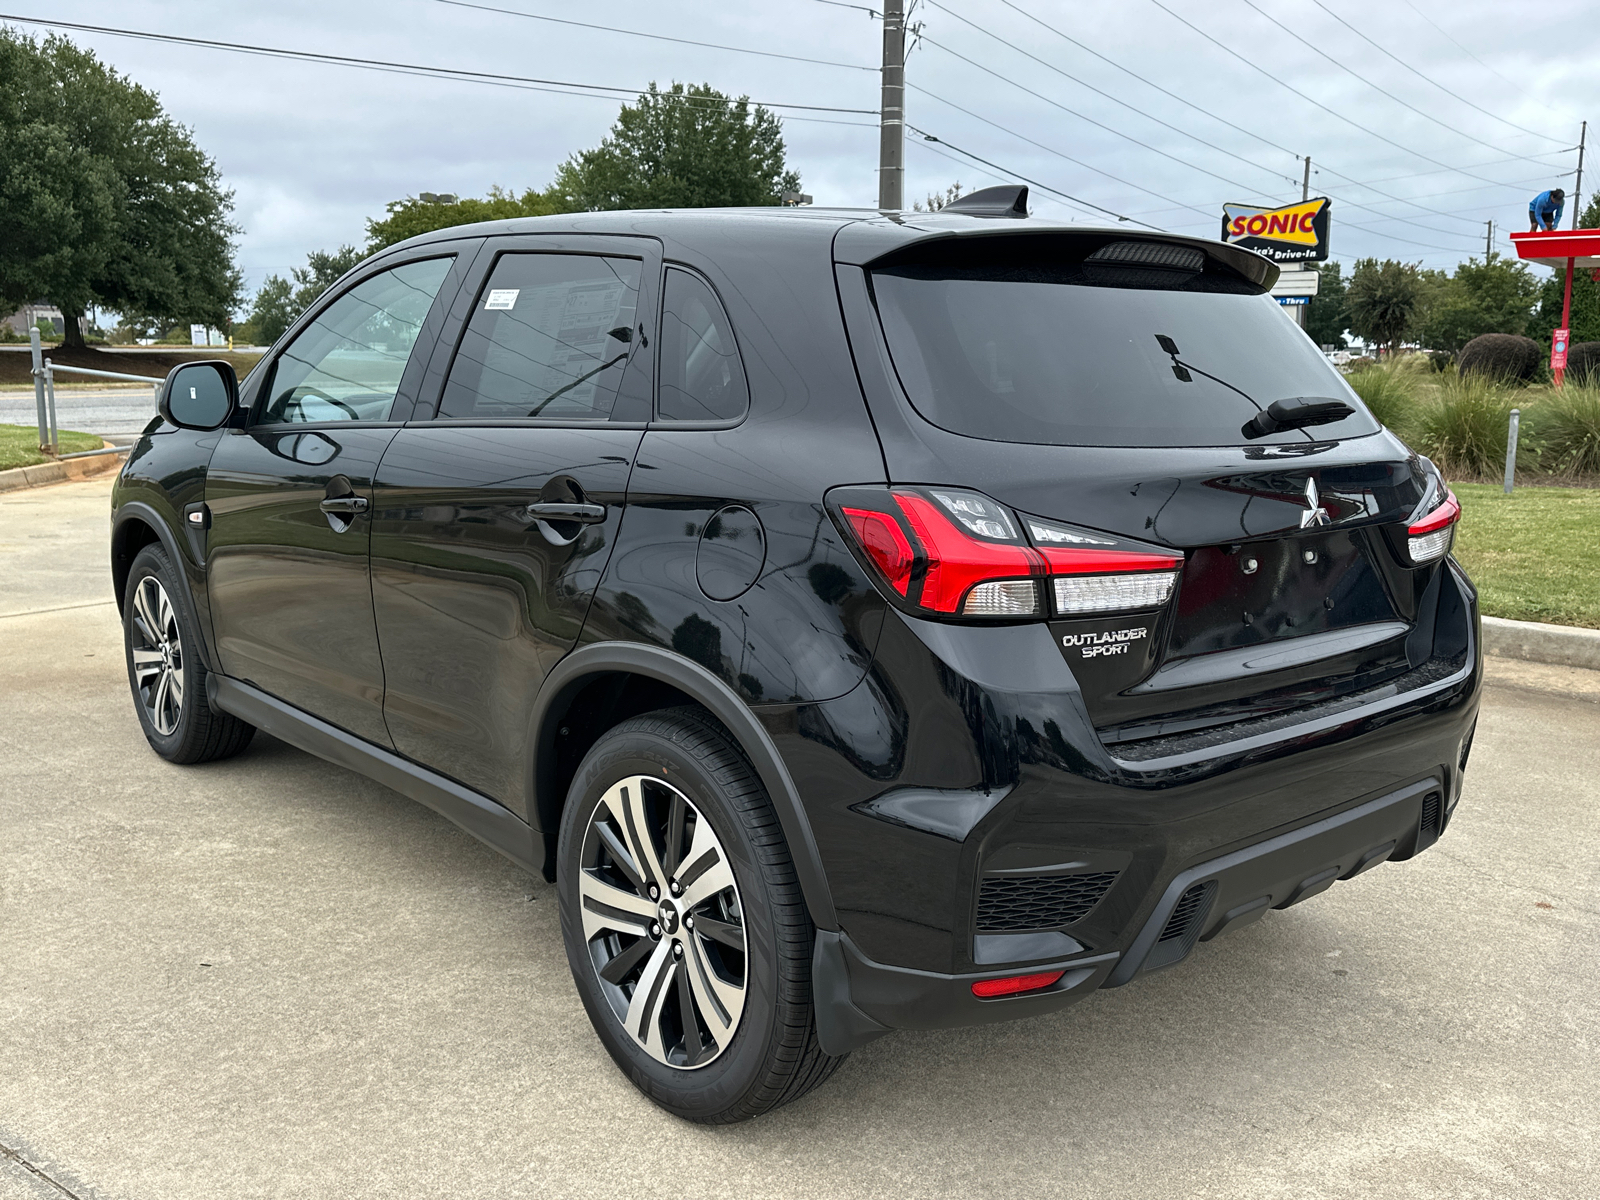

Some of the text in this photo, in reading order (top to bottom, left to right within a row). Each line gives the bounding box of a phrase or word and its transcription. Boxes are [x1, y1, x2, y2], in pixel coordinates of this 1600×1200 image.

[1231, 212, 1317, 236] SONIC
[1062, 627, 1148, 647] OUTLANDER
[1081, 642, 1131, 658] SPORT
[631, 1066, 728, 1108] NEXEN
